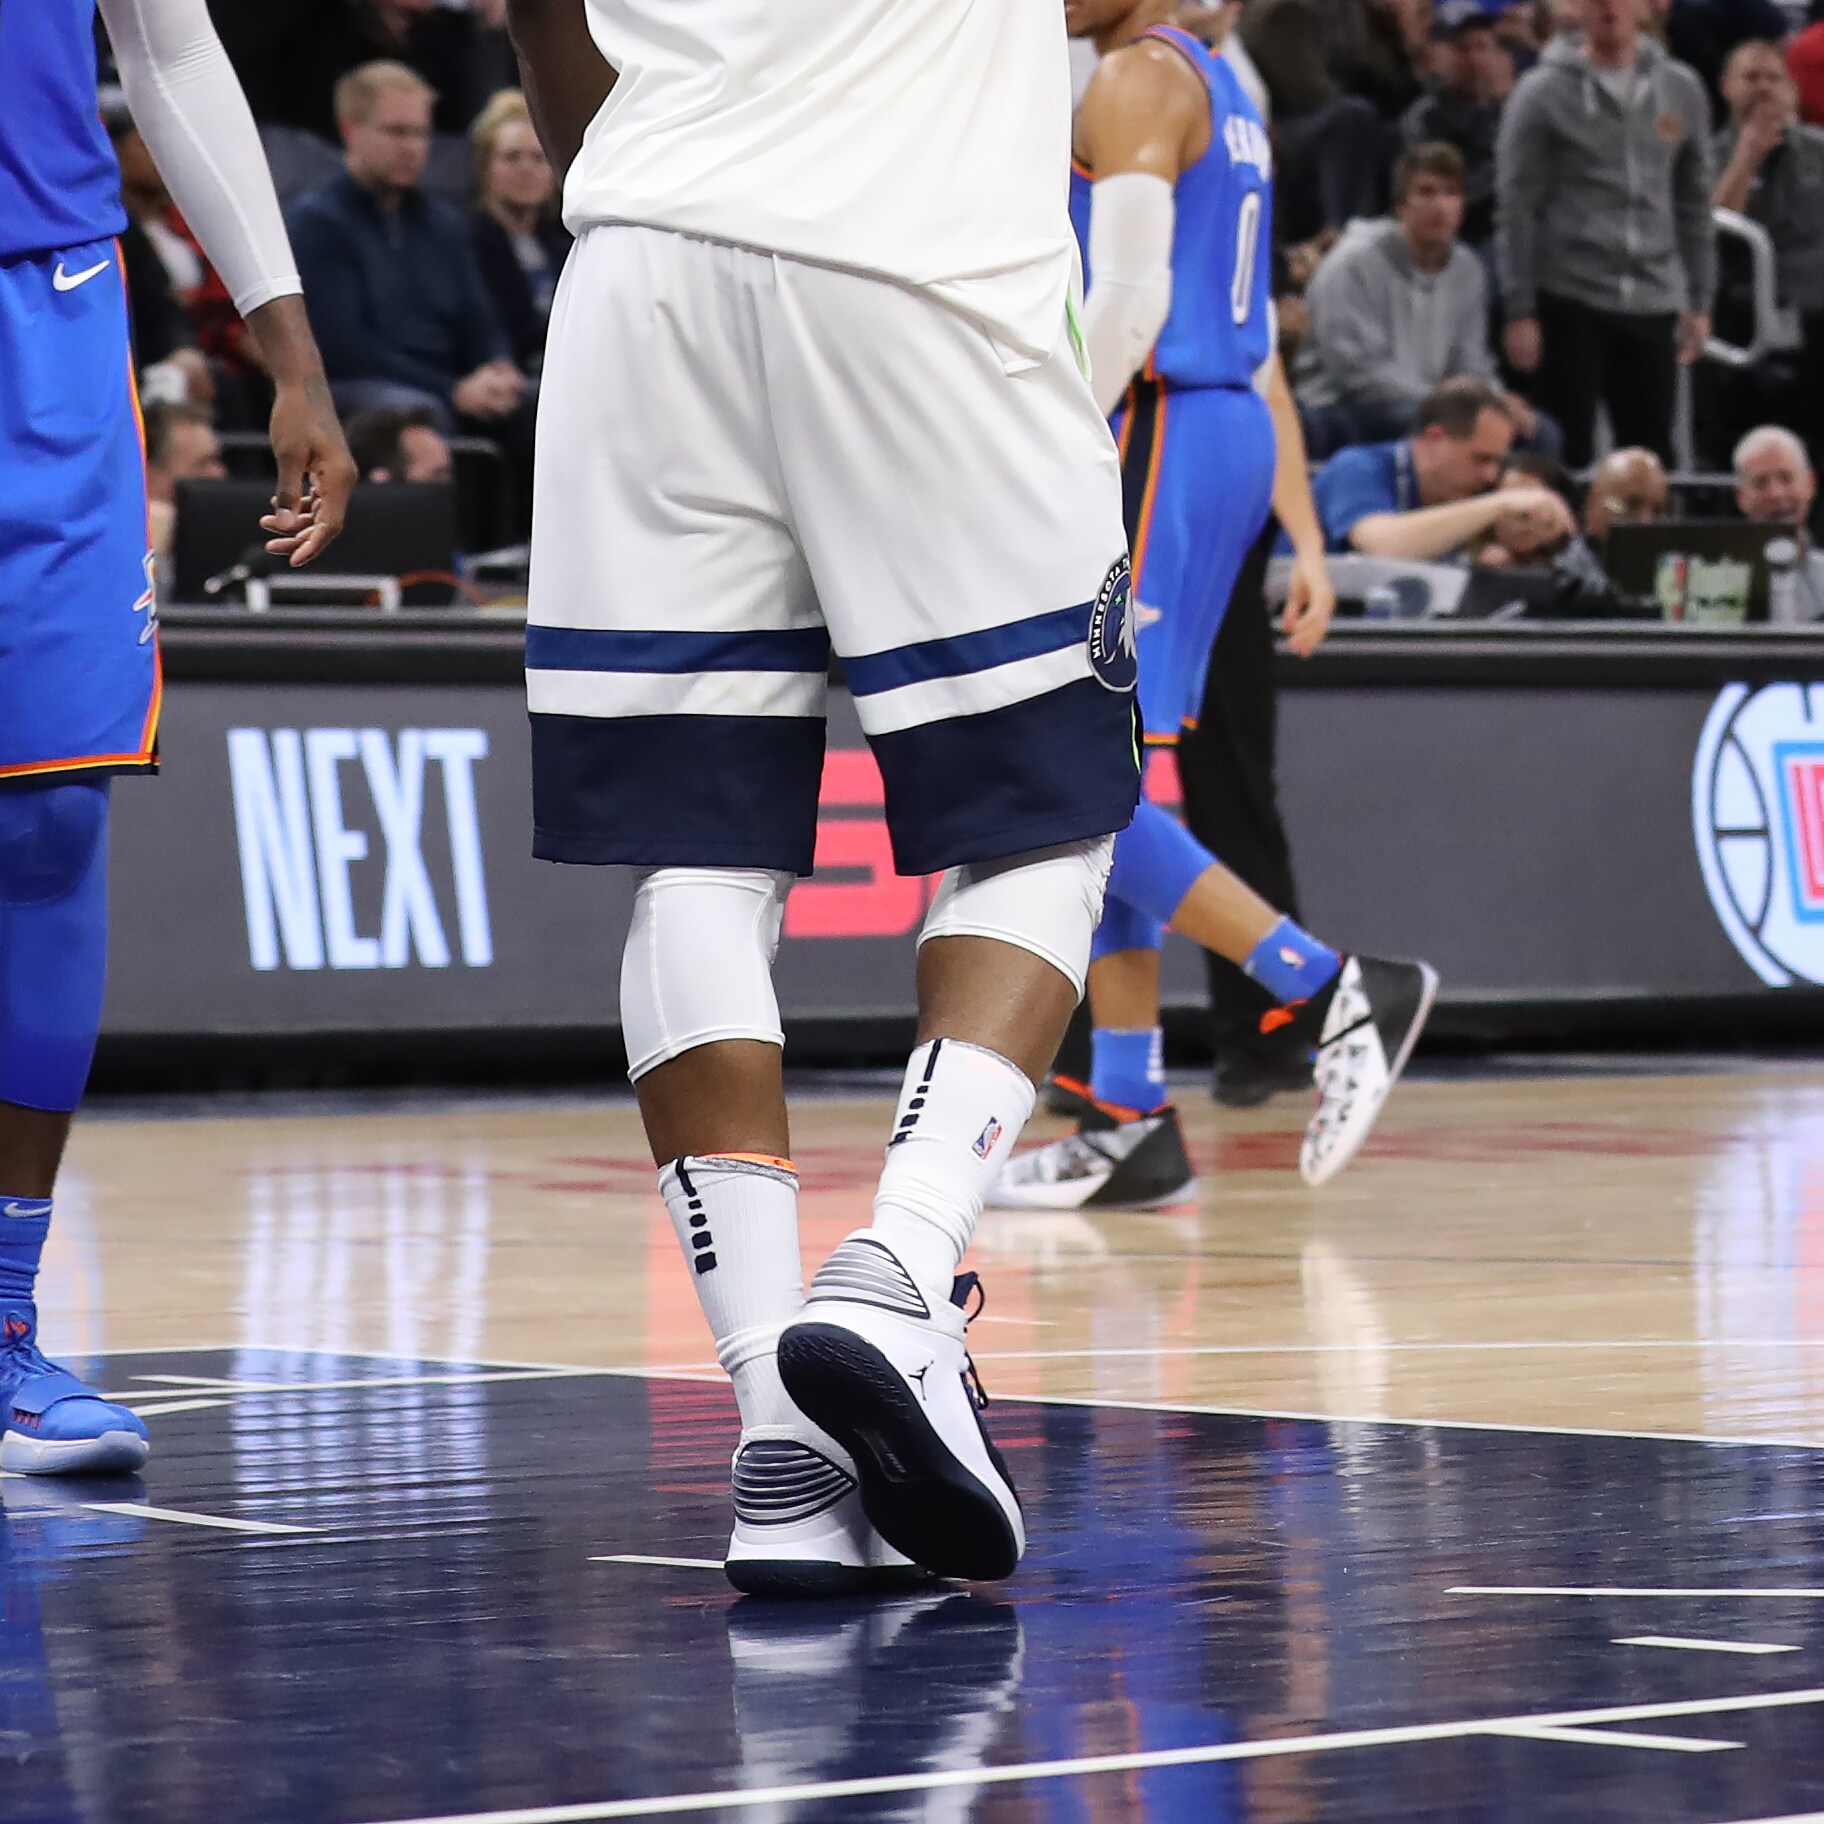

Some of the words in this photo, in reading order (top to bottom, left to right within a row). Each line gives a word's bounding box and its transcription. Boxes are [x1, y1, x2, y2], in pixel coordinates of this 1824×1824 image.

[1230, 190, 1262, 324] 0
[1090, 566, 1121, 660] MINNESOTA
[226, 728, 494, 971] NEXT
